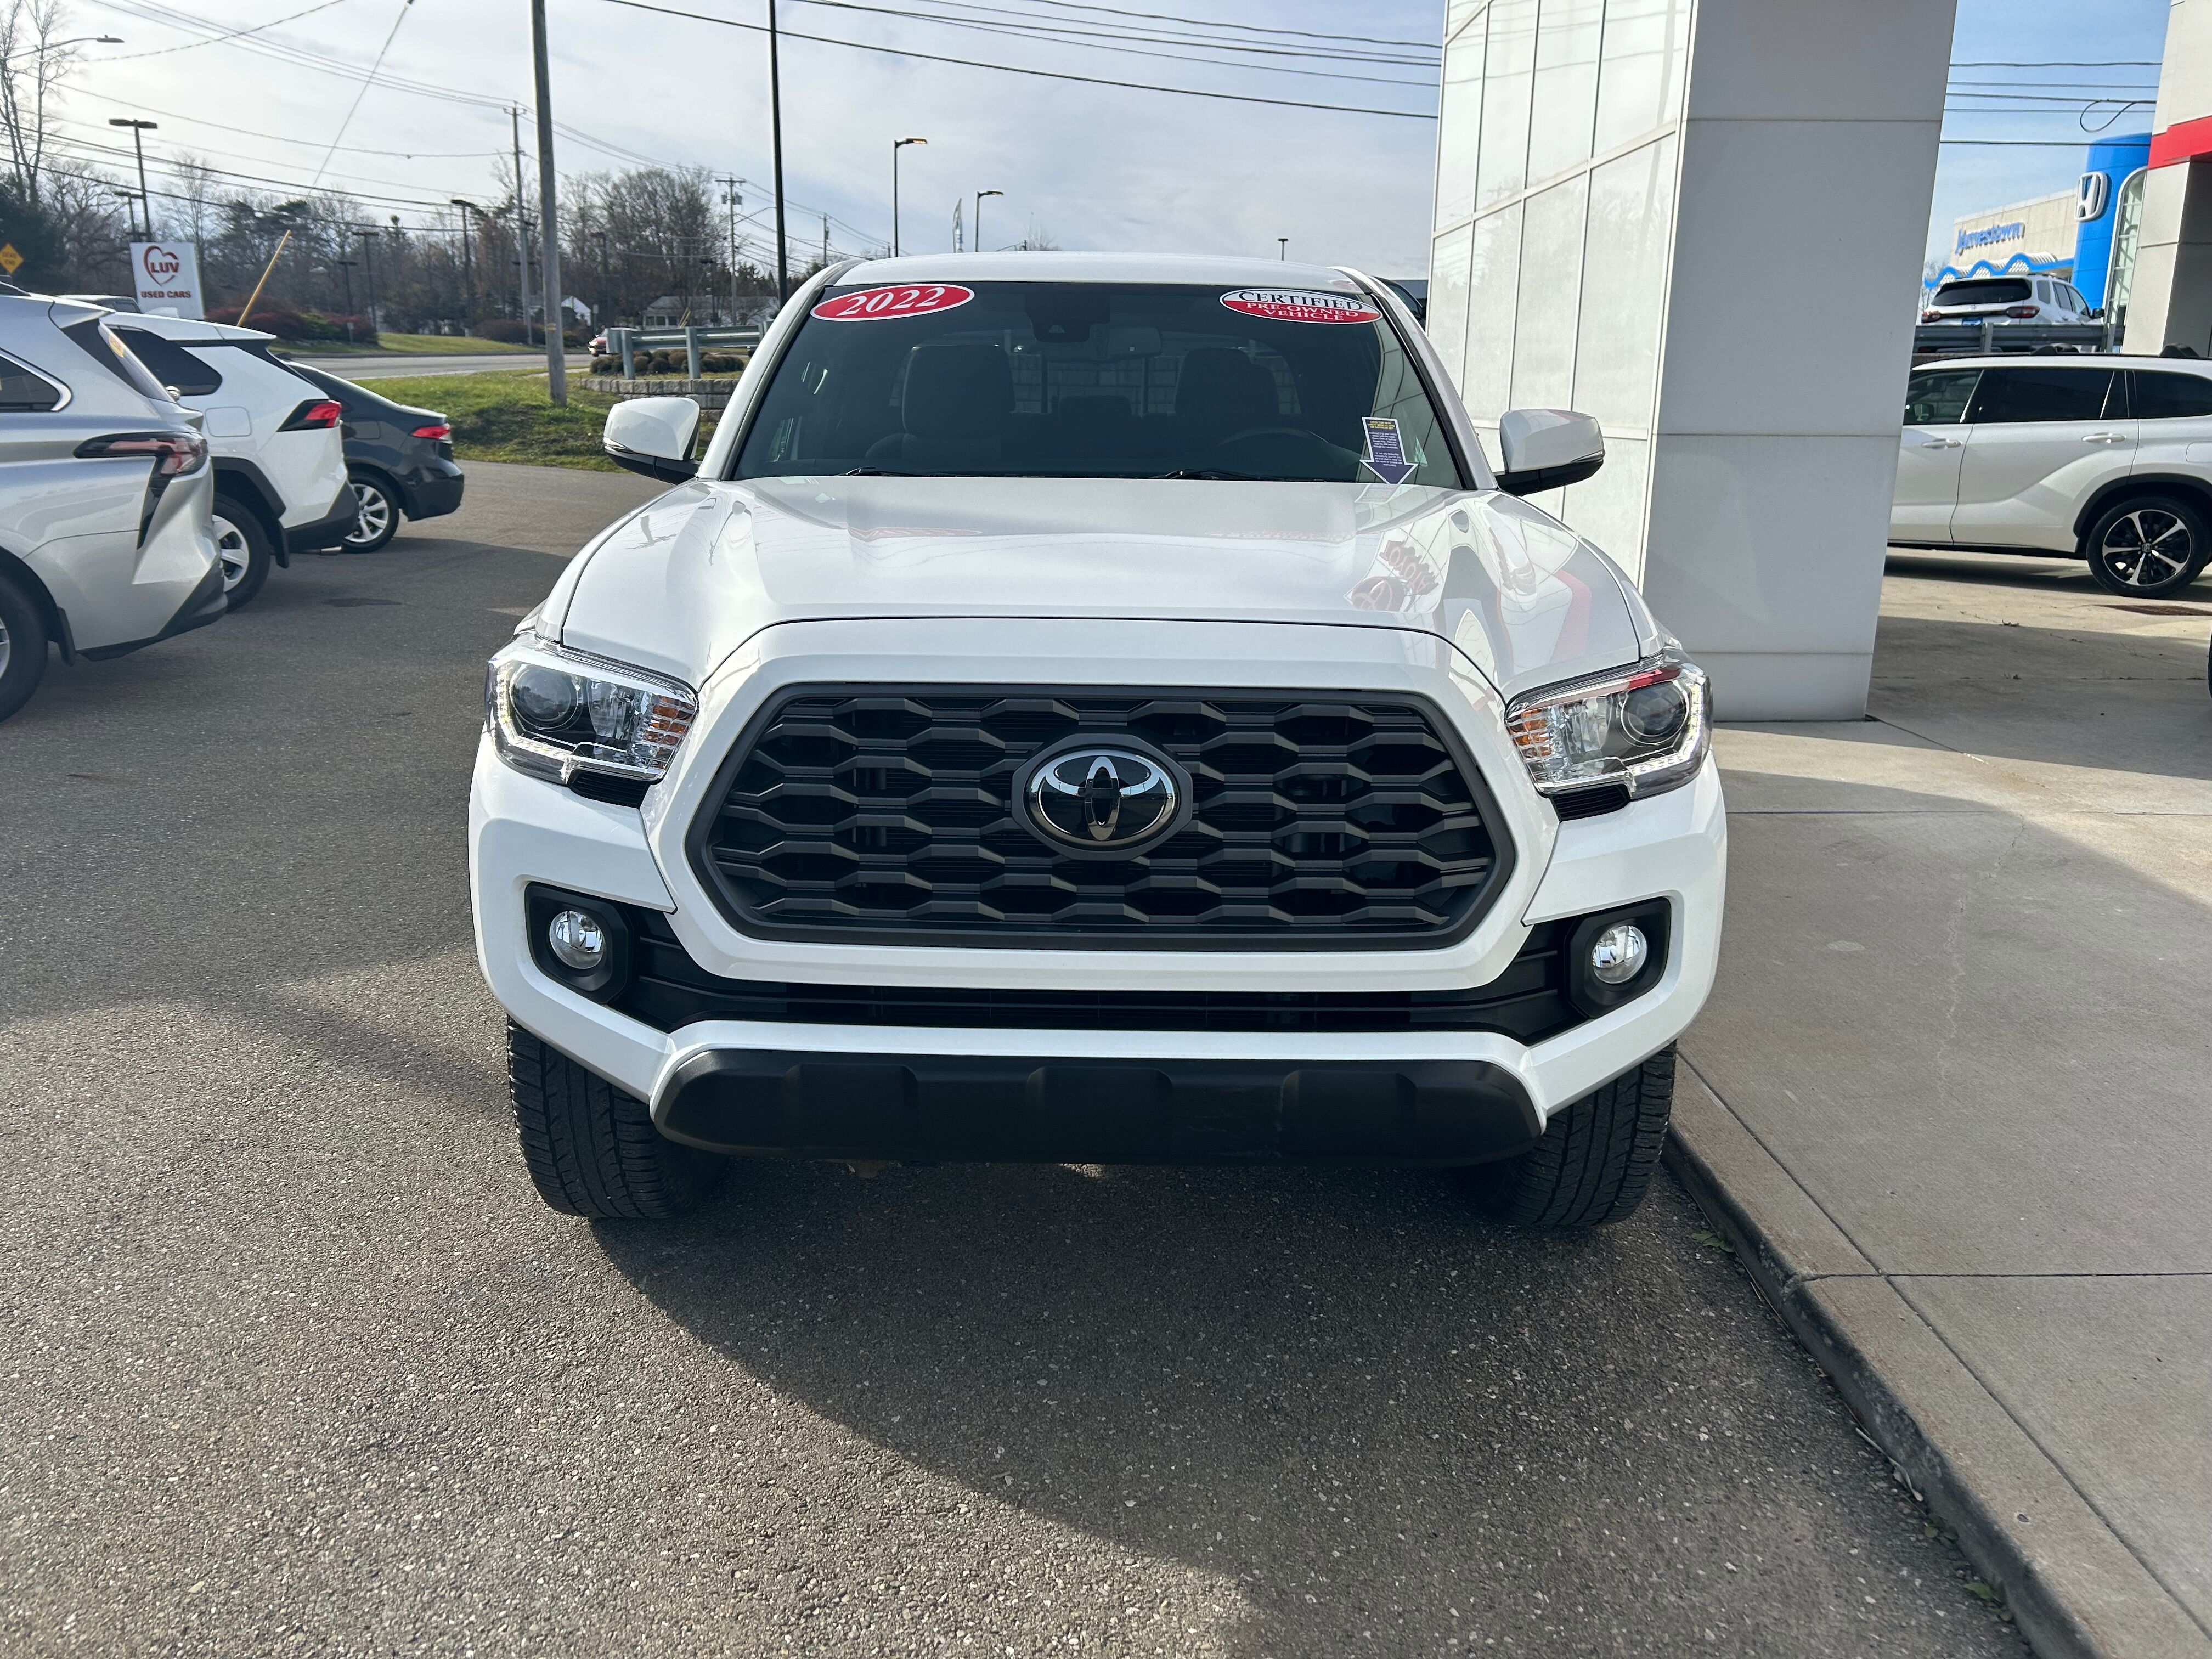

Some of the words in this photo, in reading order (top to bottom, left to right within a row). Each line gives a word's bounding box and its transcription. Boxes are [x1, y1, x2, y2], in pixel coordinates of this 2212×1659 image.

[1955, 222, 2022, 255] Jamestown
[150, 262, 180, 273] LUV
[140, 290, 165, 298] USED
[166, 290, 191, 298] CARS
[836, 287, 946, 317] 2022
[1239, 292, 1363, 311] CERTIFIED
[1246, 303, 1359, 317] PRE-OWNED
[1263, 309, 1344, 321] VEHICLE
